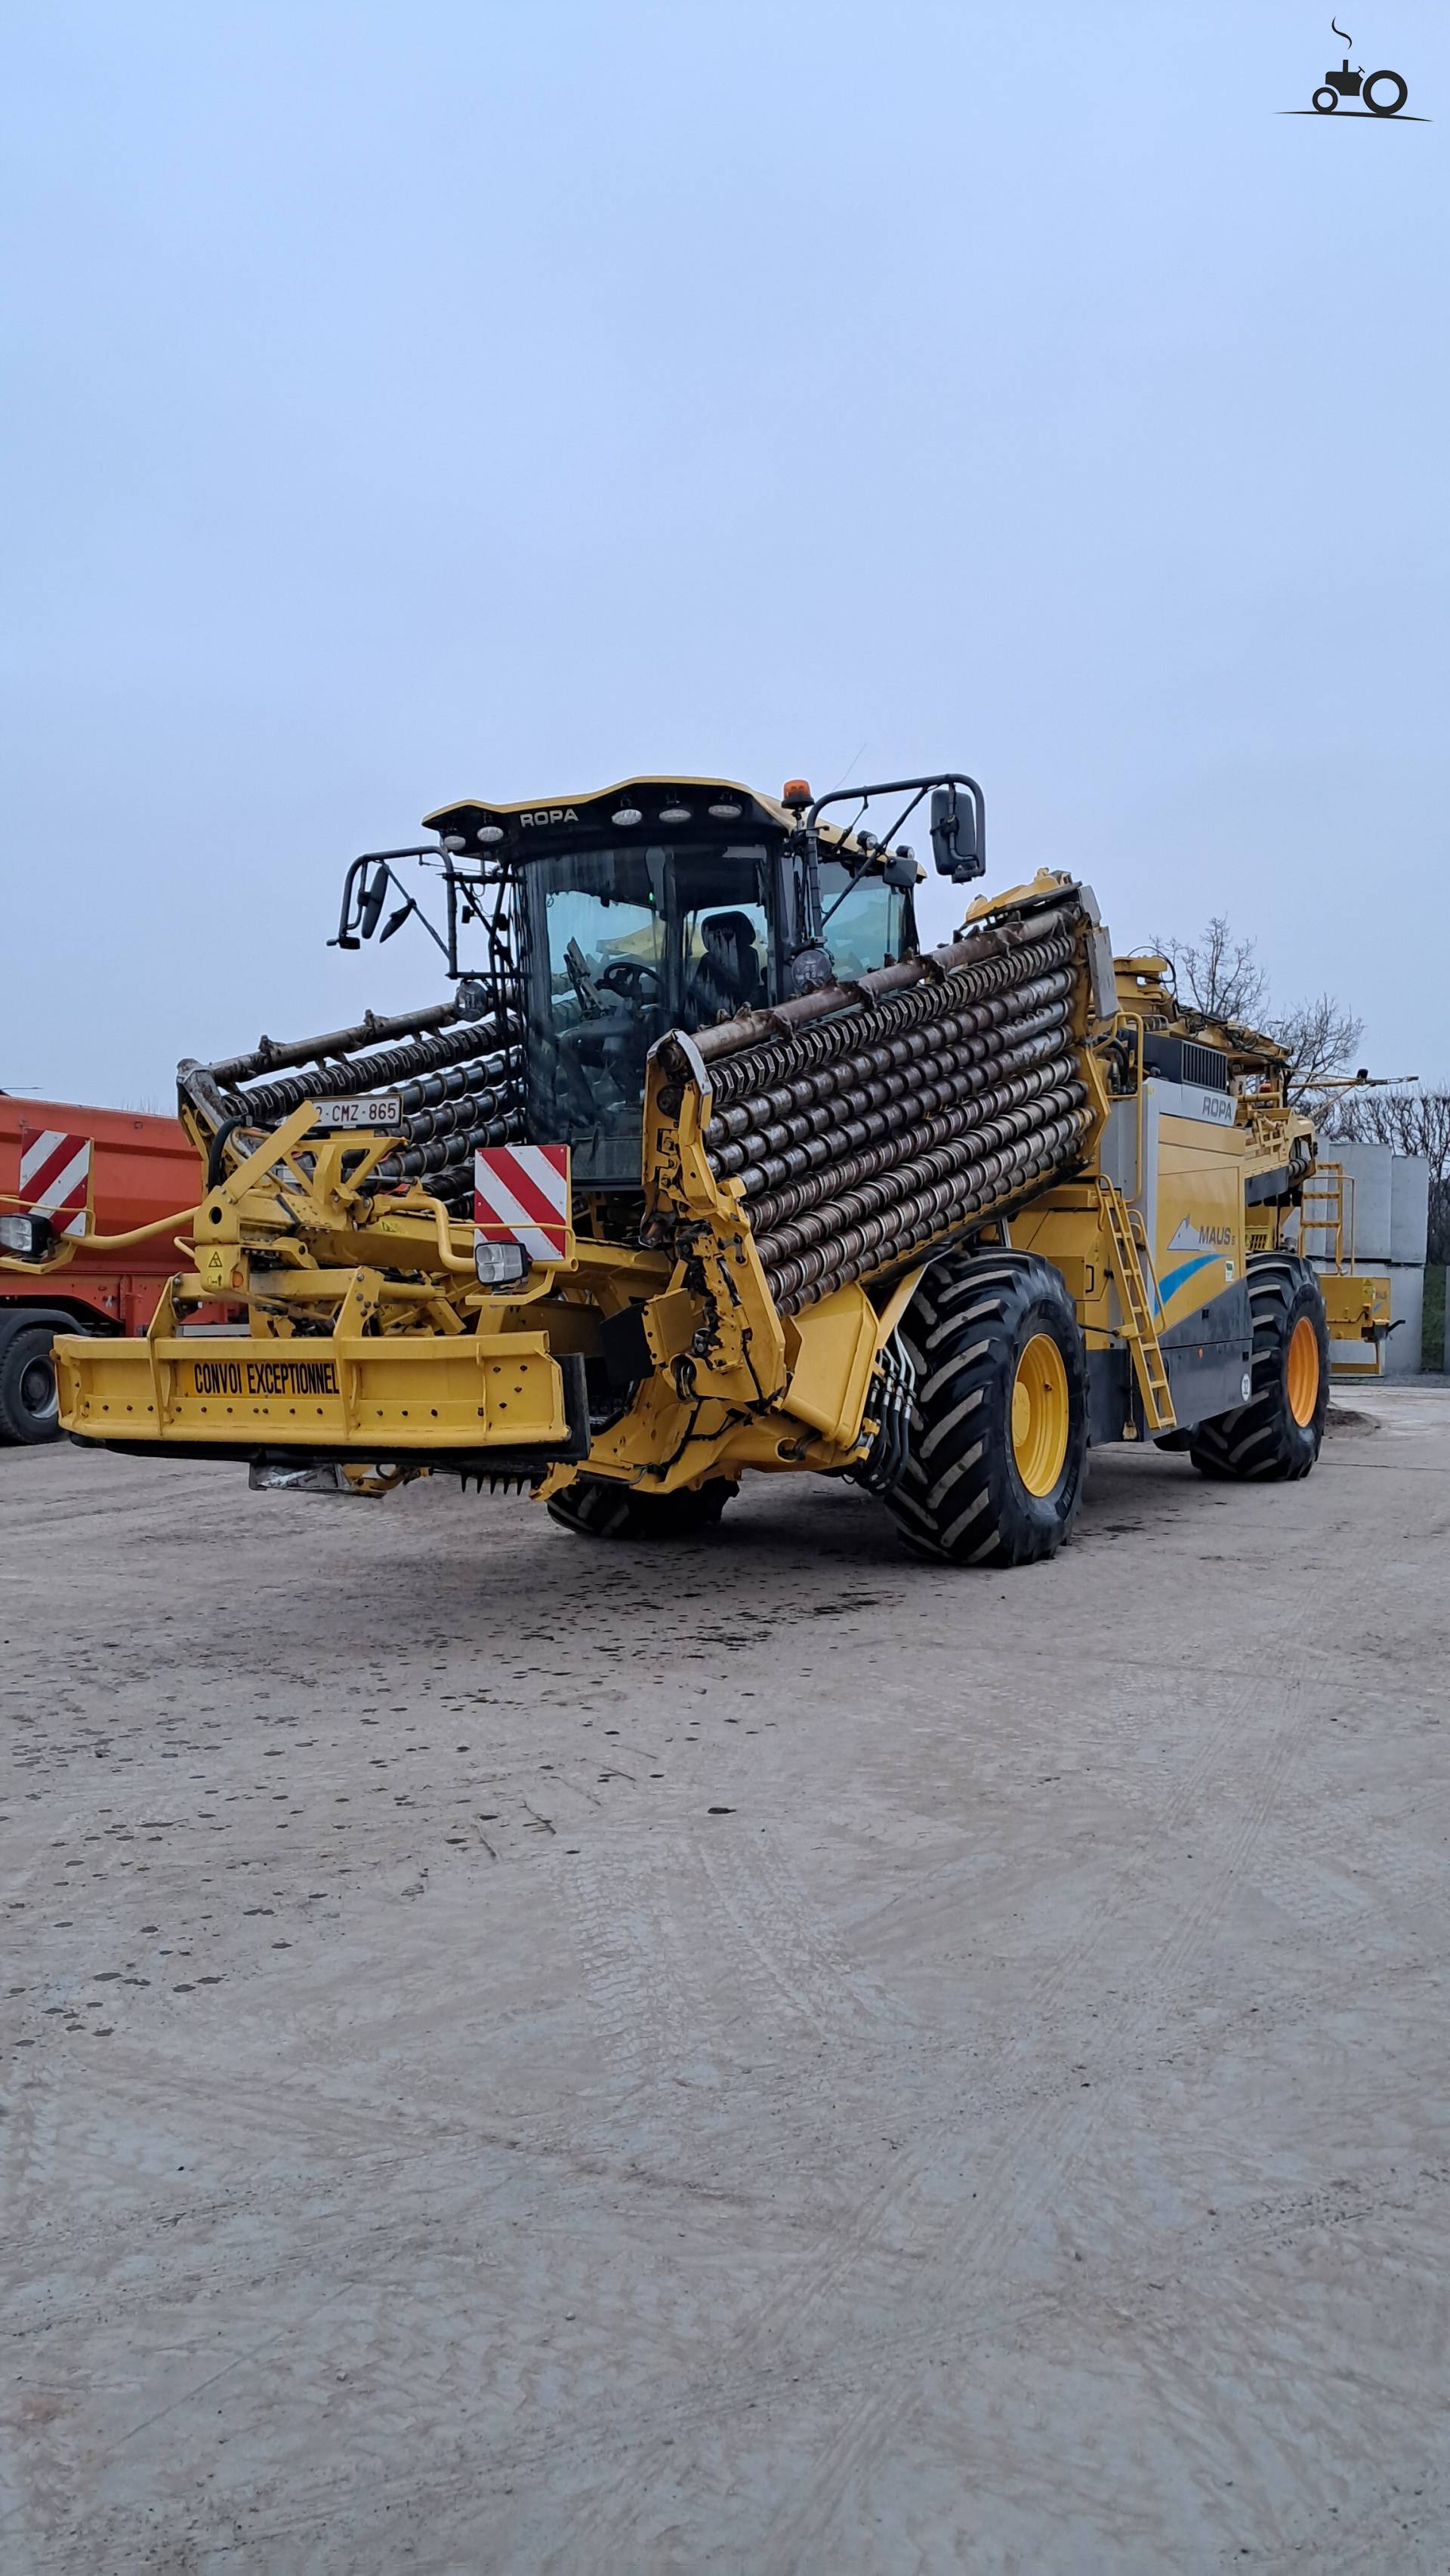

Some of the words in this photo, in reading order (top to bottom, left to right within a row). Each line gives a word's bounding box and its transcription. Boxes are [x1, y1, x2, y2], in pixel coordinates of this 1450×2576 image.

[520, 808, 579, 828] ROPA
[1202, 1096, 1232, 1120] ROPA
[1199, 1225, 1231, 1245] MAUS
[194, 1363, 242, 1394] CONVOI
[246, 1363, 340, 1394] EXCEPTIONNEL
